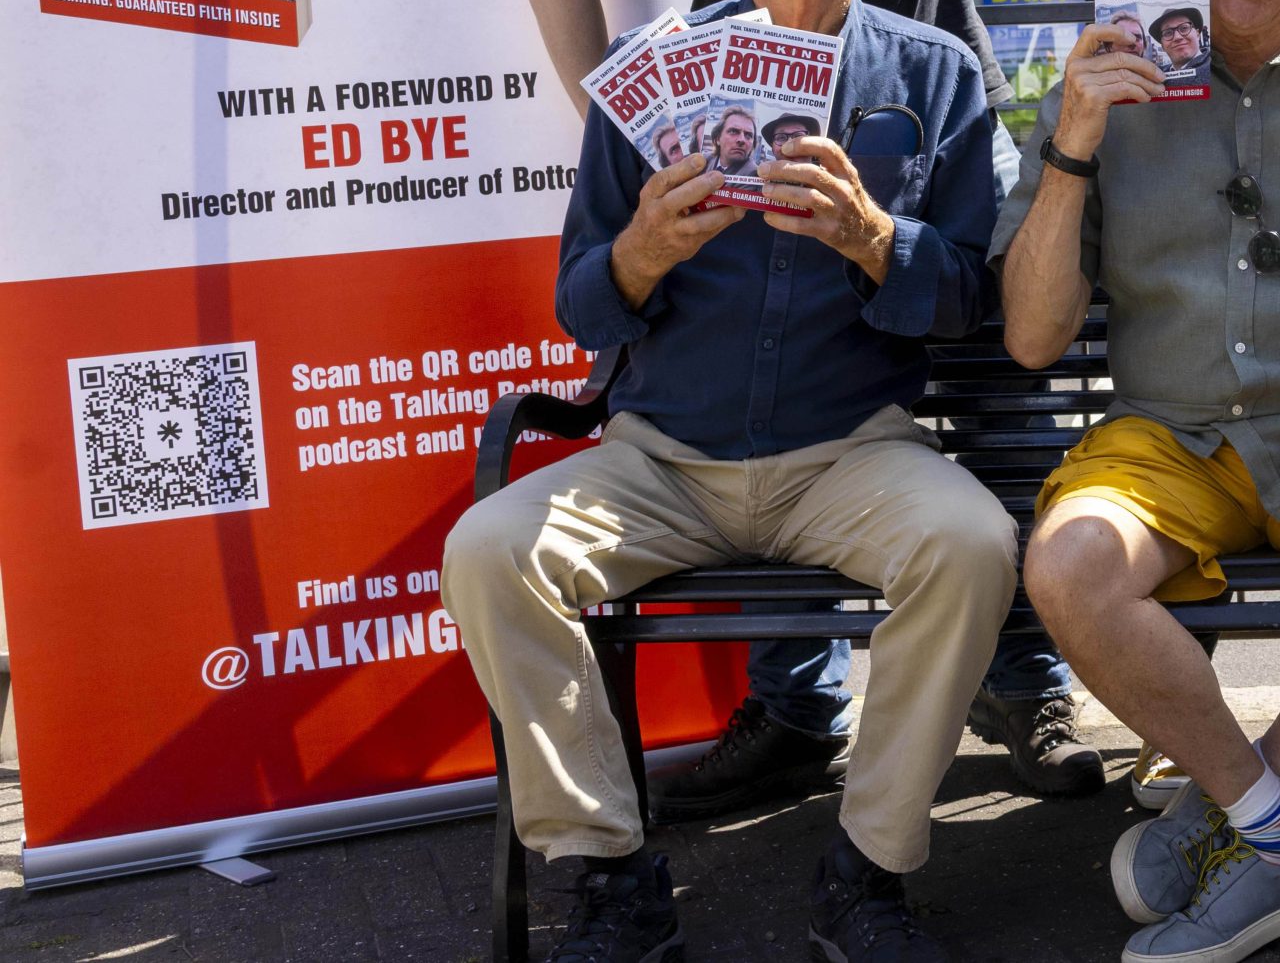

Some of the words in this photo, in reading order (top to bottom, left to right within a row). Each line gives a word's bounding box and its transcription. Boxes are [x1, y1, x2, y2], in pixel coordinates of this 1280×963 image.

[200, 5, 231, 22] FILTH
[236, 10, 280, 27] INSIDE
[604, 50, 654, 93] TALKI
[669, 42, 720, 62] TALK
[736, 38, 827, 62] TALKING
[218, 87, 295, 118] WITH
[307, 85, 326, 112] A
[335, 75, 493, 111] FOREWORD
[503, 72, 538, 99] BY
[723, 50, 832, 96] BOTTOM
[727, 85, 749, 94] GUIDE
[763, 91, 776, 99] THE
[778, 93, 796, 103] CULT
[798, 96, 826, 108] SITCOM
[301, 122, 362, 170] ED
[382, 116, 469, 164] BYE
[161, 185, 276, 221] Director
[286, 180, 336, 212] and
[346, 172, 469, 208] Producer
[478, 168, 502, 196] of
[512, 165, 578, 192] Botto
[292, 363, 360, 392] Scan
[369, 357, 412, 384] the
[422, 350, 459, 381] QR
[469, 343, 531, 373] code
[540, 340, 576, 366] for
[296, 405, 328, 430] on
[338, 398, 381, 425] the
[391, 387, 489, 420] Talking
[299, 431, 405, 471] podcast
[416, 424, 464, 456] and
[298, 575, 355, 608] Find
[366, 574, 398, 600] us
[407, 570, 439, 595] on
[202, 608, 466, 690] @TALKING
